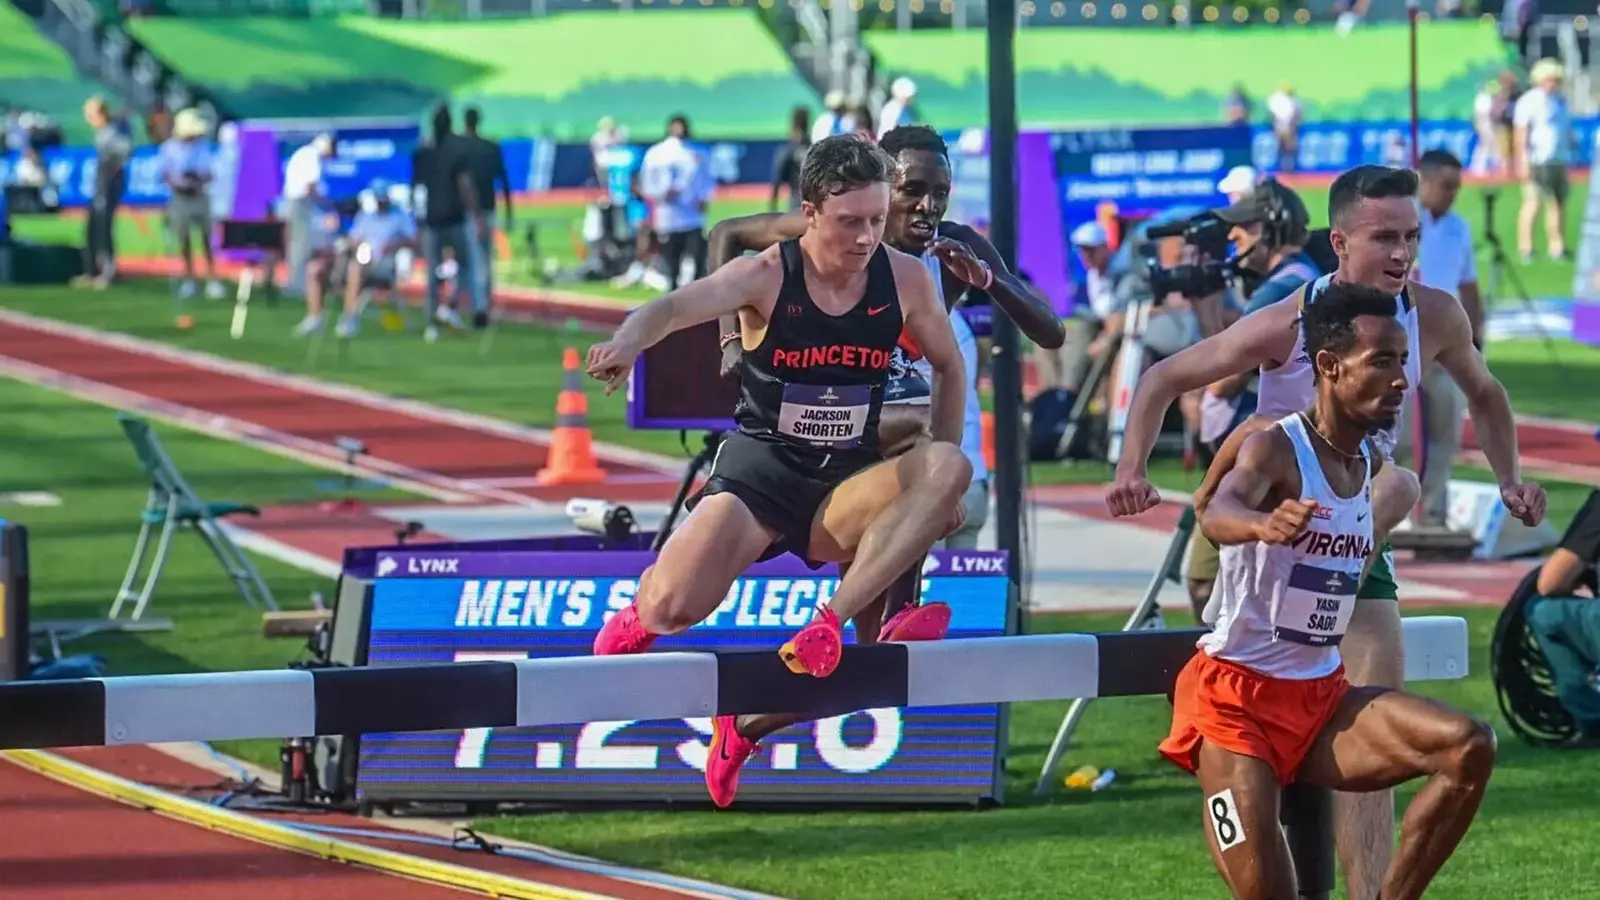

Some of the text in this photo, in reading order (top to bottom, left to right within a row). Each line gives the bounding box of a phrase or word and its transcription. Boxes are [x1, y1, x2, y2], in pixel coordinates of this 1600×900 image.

[800, 409, 851, 421] JACKSON
[793, 421, 854, 437] SHORTEN
[408, 558, 459, 573] LYNX
[951, 556, 1003, 571] LYNX
[455, 580, 596, 627] MEN'S
[1316, 597, 1341, 612] YASIN
[1307, 613, 1337, 631] SADO
[1212, 797, 1236, 844] 8
